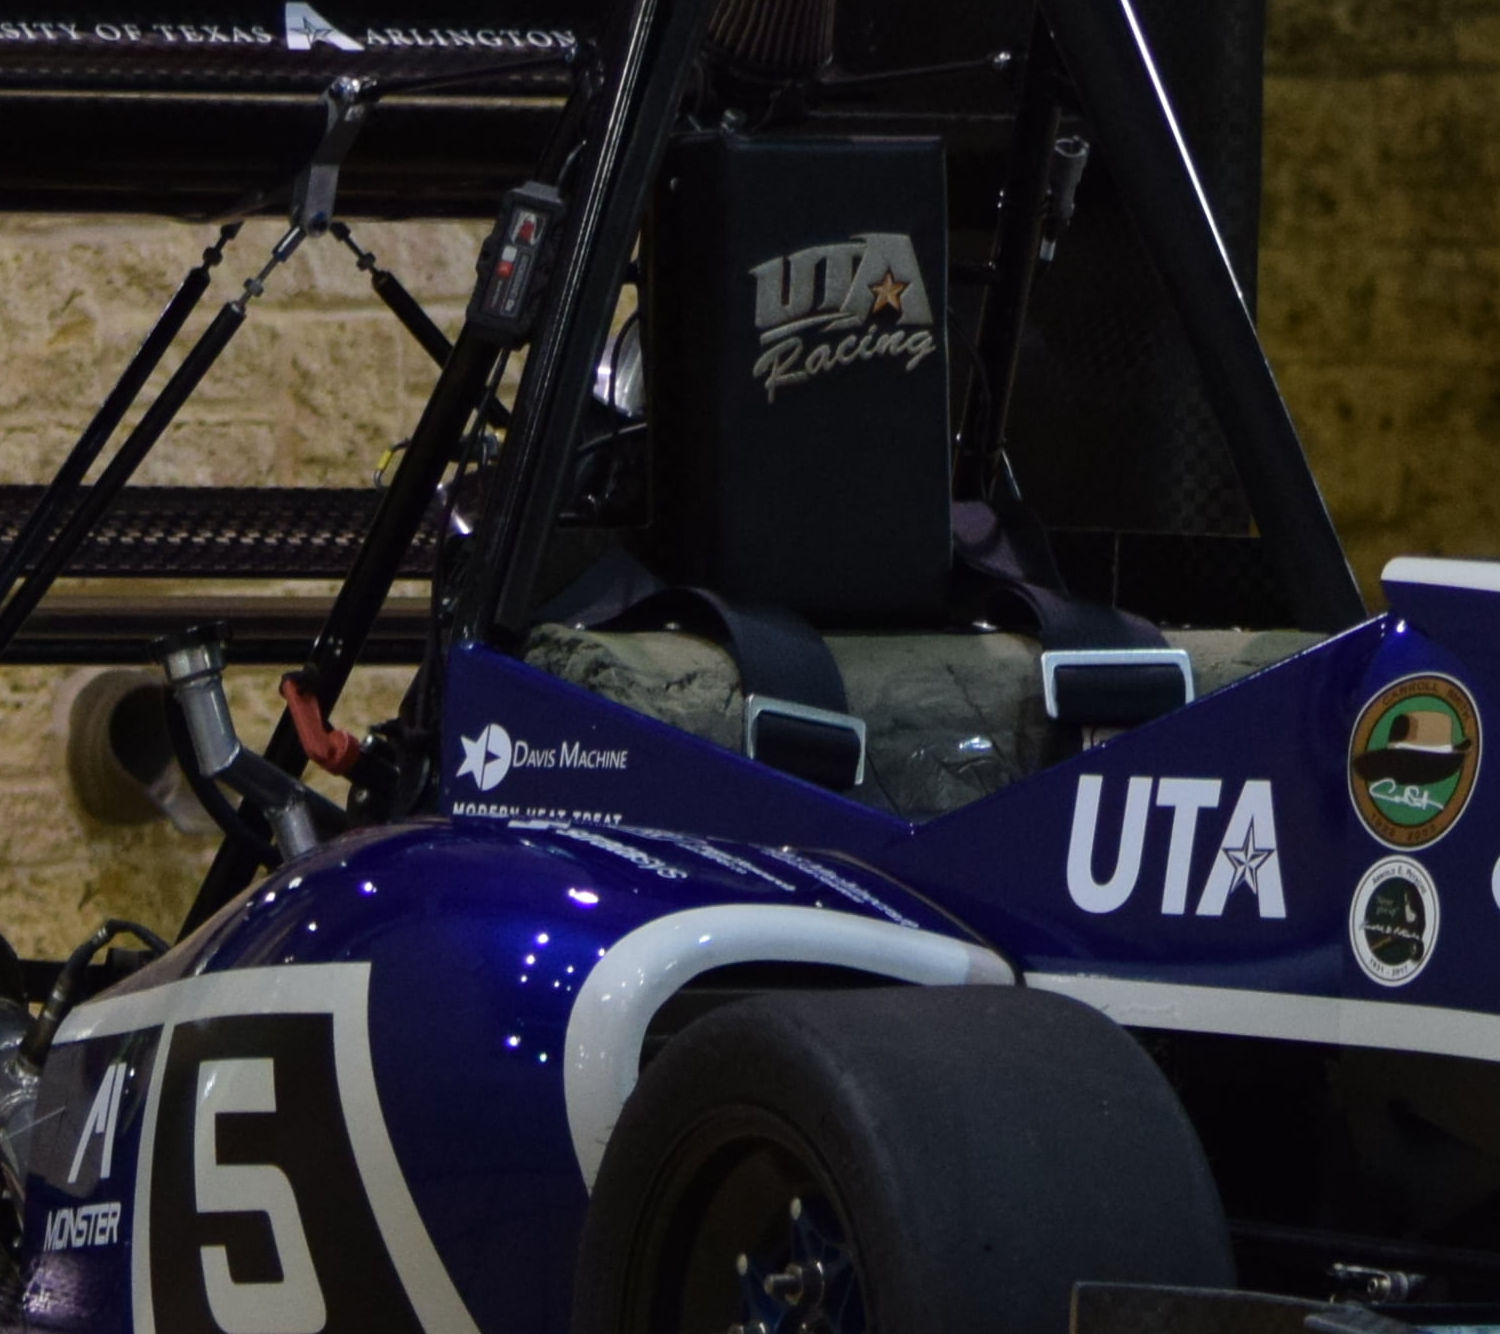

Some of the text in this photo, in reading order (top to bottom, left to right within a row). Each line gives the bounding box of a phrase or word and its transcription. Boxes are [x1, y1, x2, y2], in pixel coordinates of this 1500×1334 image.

[94, 23, 142, 42] OF
[152, 24, 273, 43] TEXAS
[366, 27, 577, 49] ARLINGTON
[753, 324, 936, 404] Racing
[1066, 774, 1286, 918] UTA
[44, 1202, 121, 1252] MONSTER
